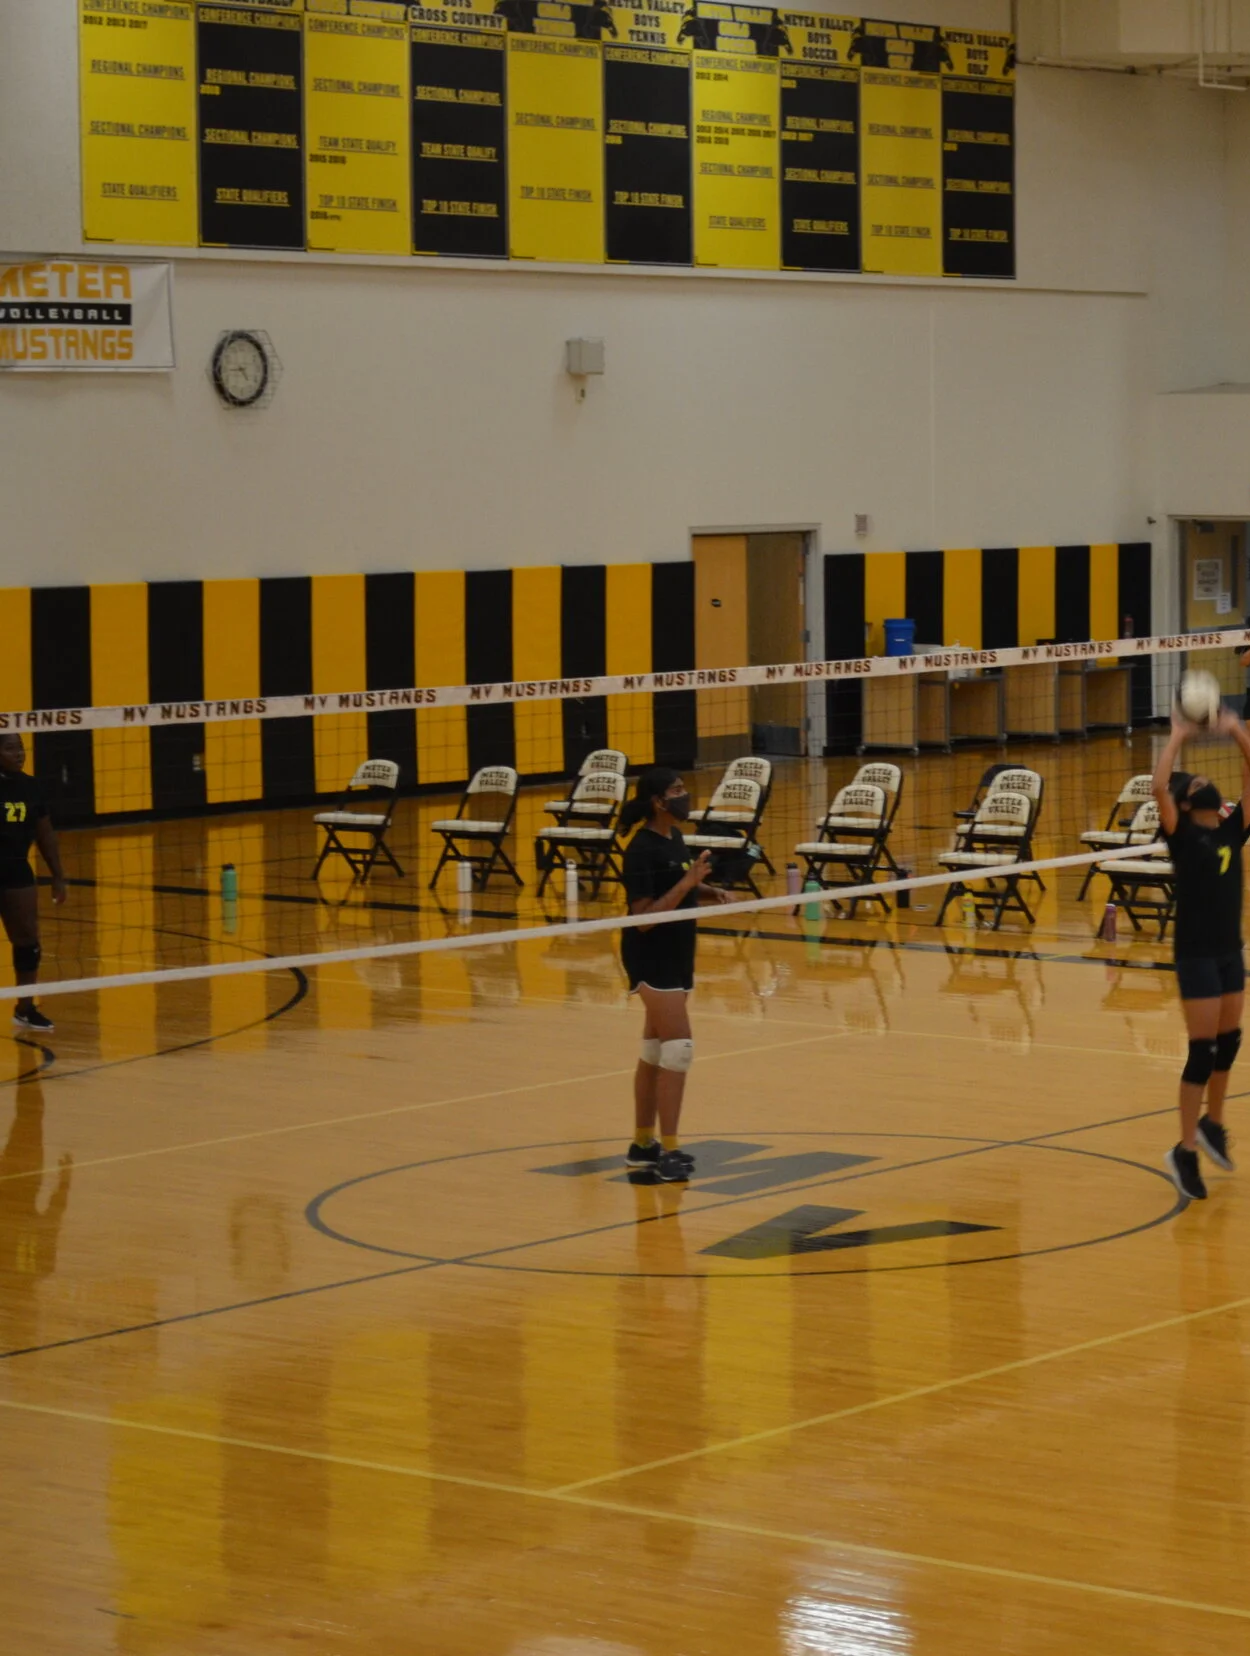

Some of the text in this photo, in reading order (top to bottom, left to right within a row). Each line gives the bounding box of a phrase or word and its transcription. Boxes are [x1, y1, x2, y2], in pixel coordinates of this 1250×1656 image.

[411, 9, 503, 28] CROSS COUNTRY
[634, 14, 660, 27] BOYS
[819, 15, 854, 31] VALLEY
[628, 29, 666, 44] TENNIS
[807, 31, 832, 44] BOYS
[802, 46, 837, 61] SOCCER
[92, 60, 184, 78] REGIONAL CHAMPIONS
[90, 121, 186, 139] SECTIONAL CHAMPIONS
[102, 182, 177, 199] STATE QUALIFIERS
[1046, 641, 1114, 658] MUSTANGS
[925, 651, 998, 668] MUSTANGS
[794, 660, 872, 677] MUSTANGS
[654, 669, 737, 687] MUSTANGS
[503, 679, 592, 697] MUSTANGS
[339, 689, 436, 708] MUSTANGS
[161, 698, 267, 720] MUSTANGS
[5, 802, 27, 823] 27
[1217, 845, 1232, 876] 7
